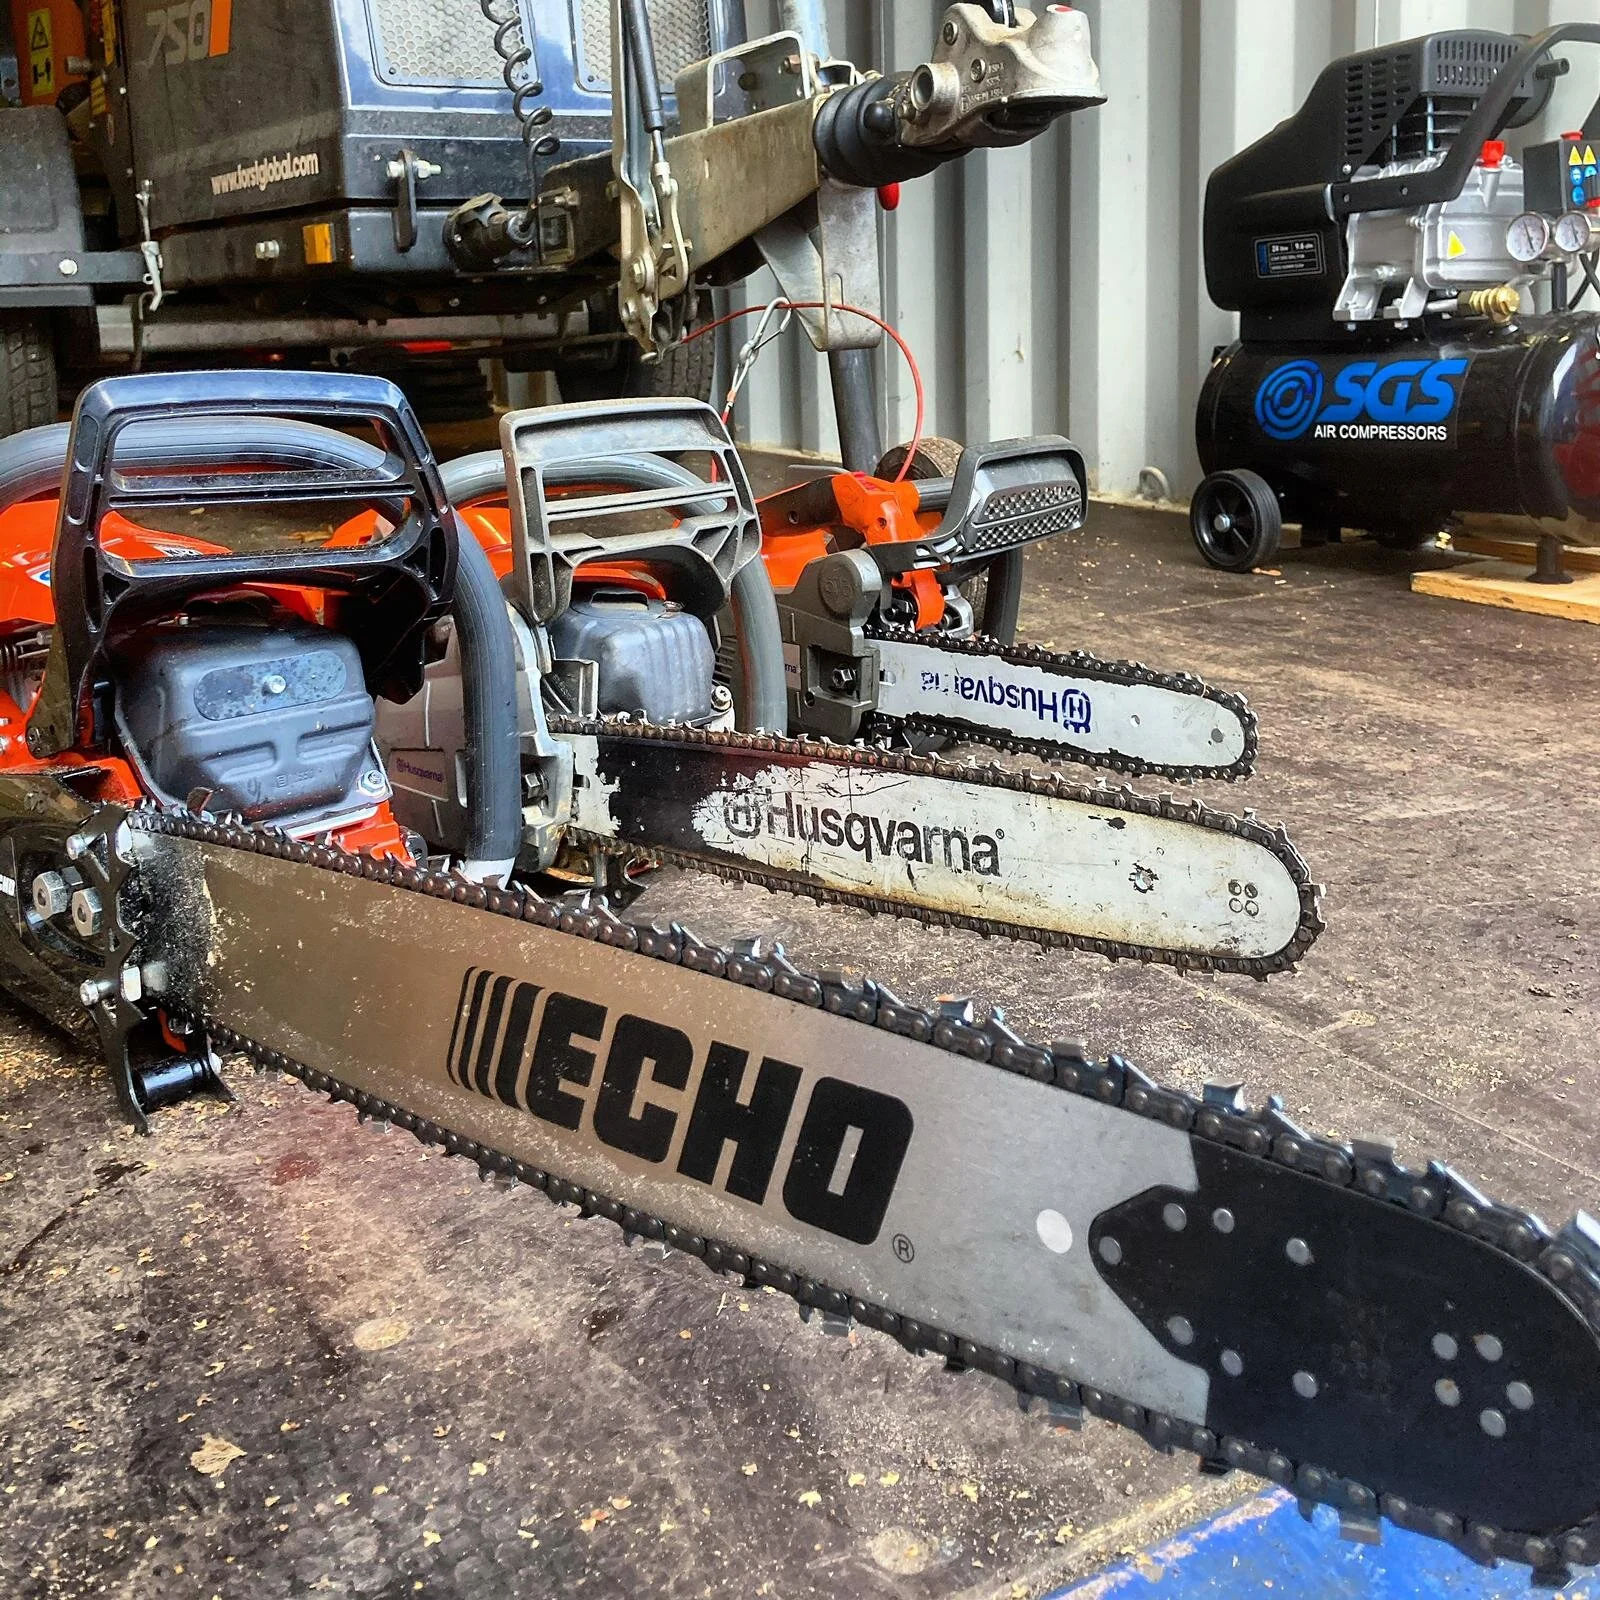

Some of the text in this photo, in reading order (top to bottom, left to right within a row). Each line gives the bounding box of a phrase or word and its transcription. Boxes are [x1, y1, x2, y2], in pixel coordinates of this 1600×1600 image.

[144, 0, 211, 67] 750
[1316, 358, 1468, 423] SGS
[1314, 425, 1447, 440] AIR COMPRESSORS
[526, 991, 914, 1245] ECHO
